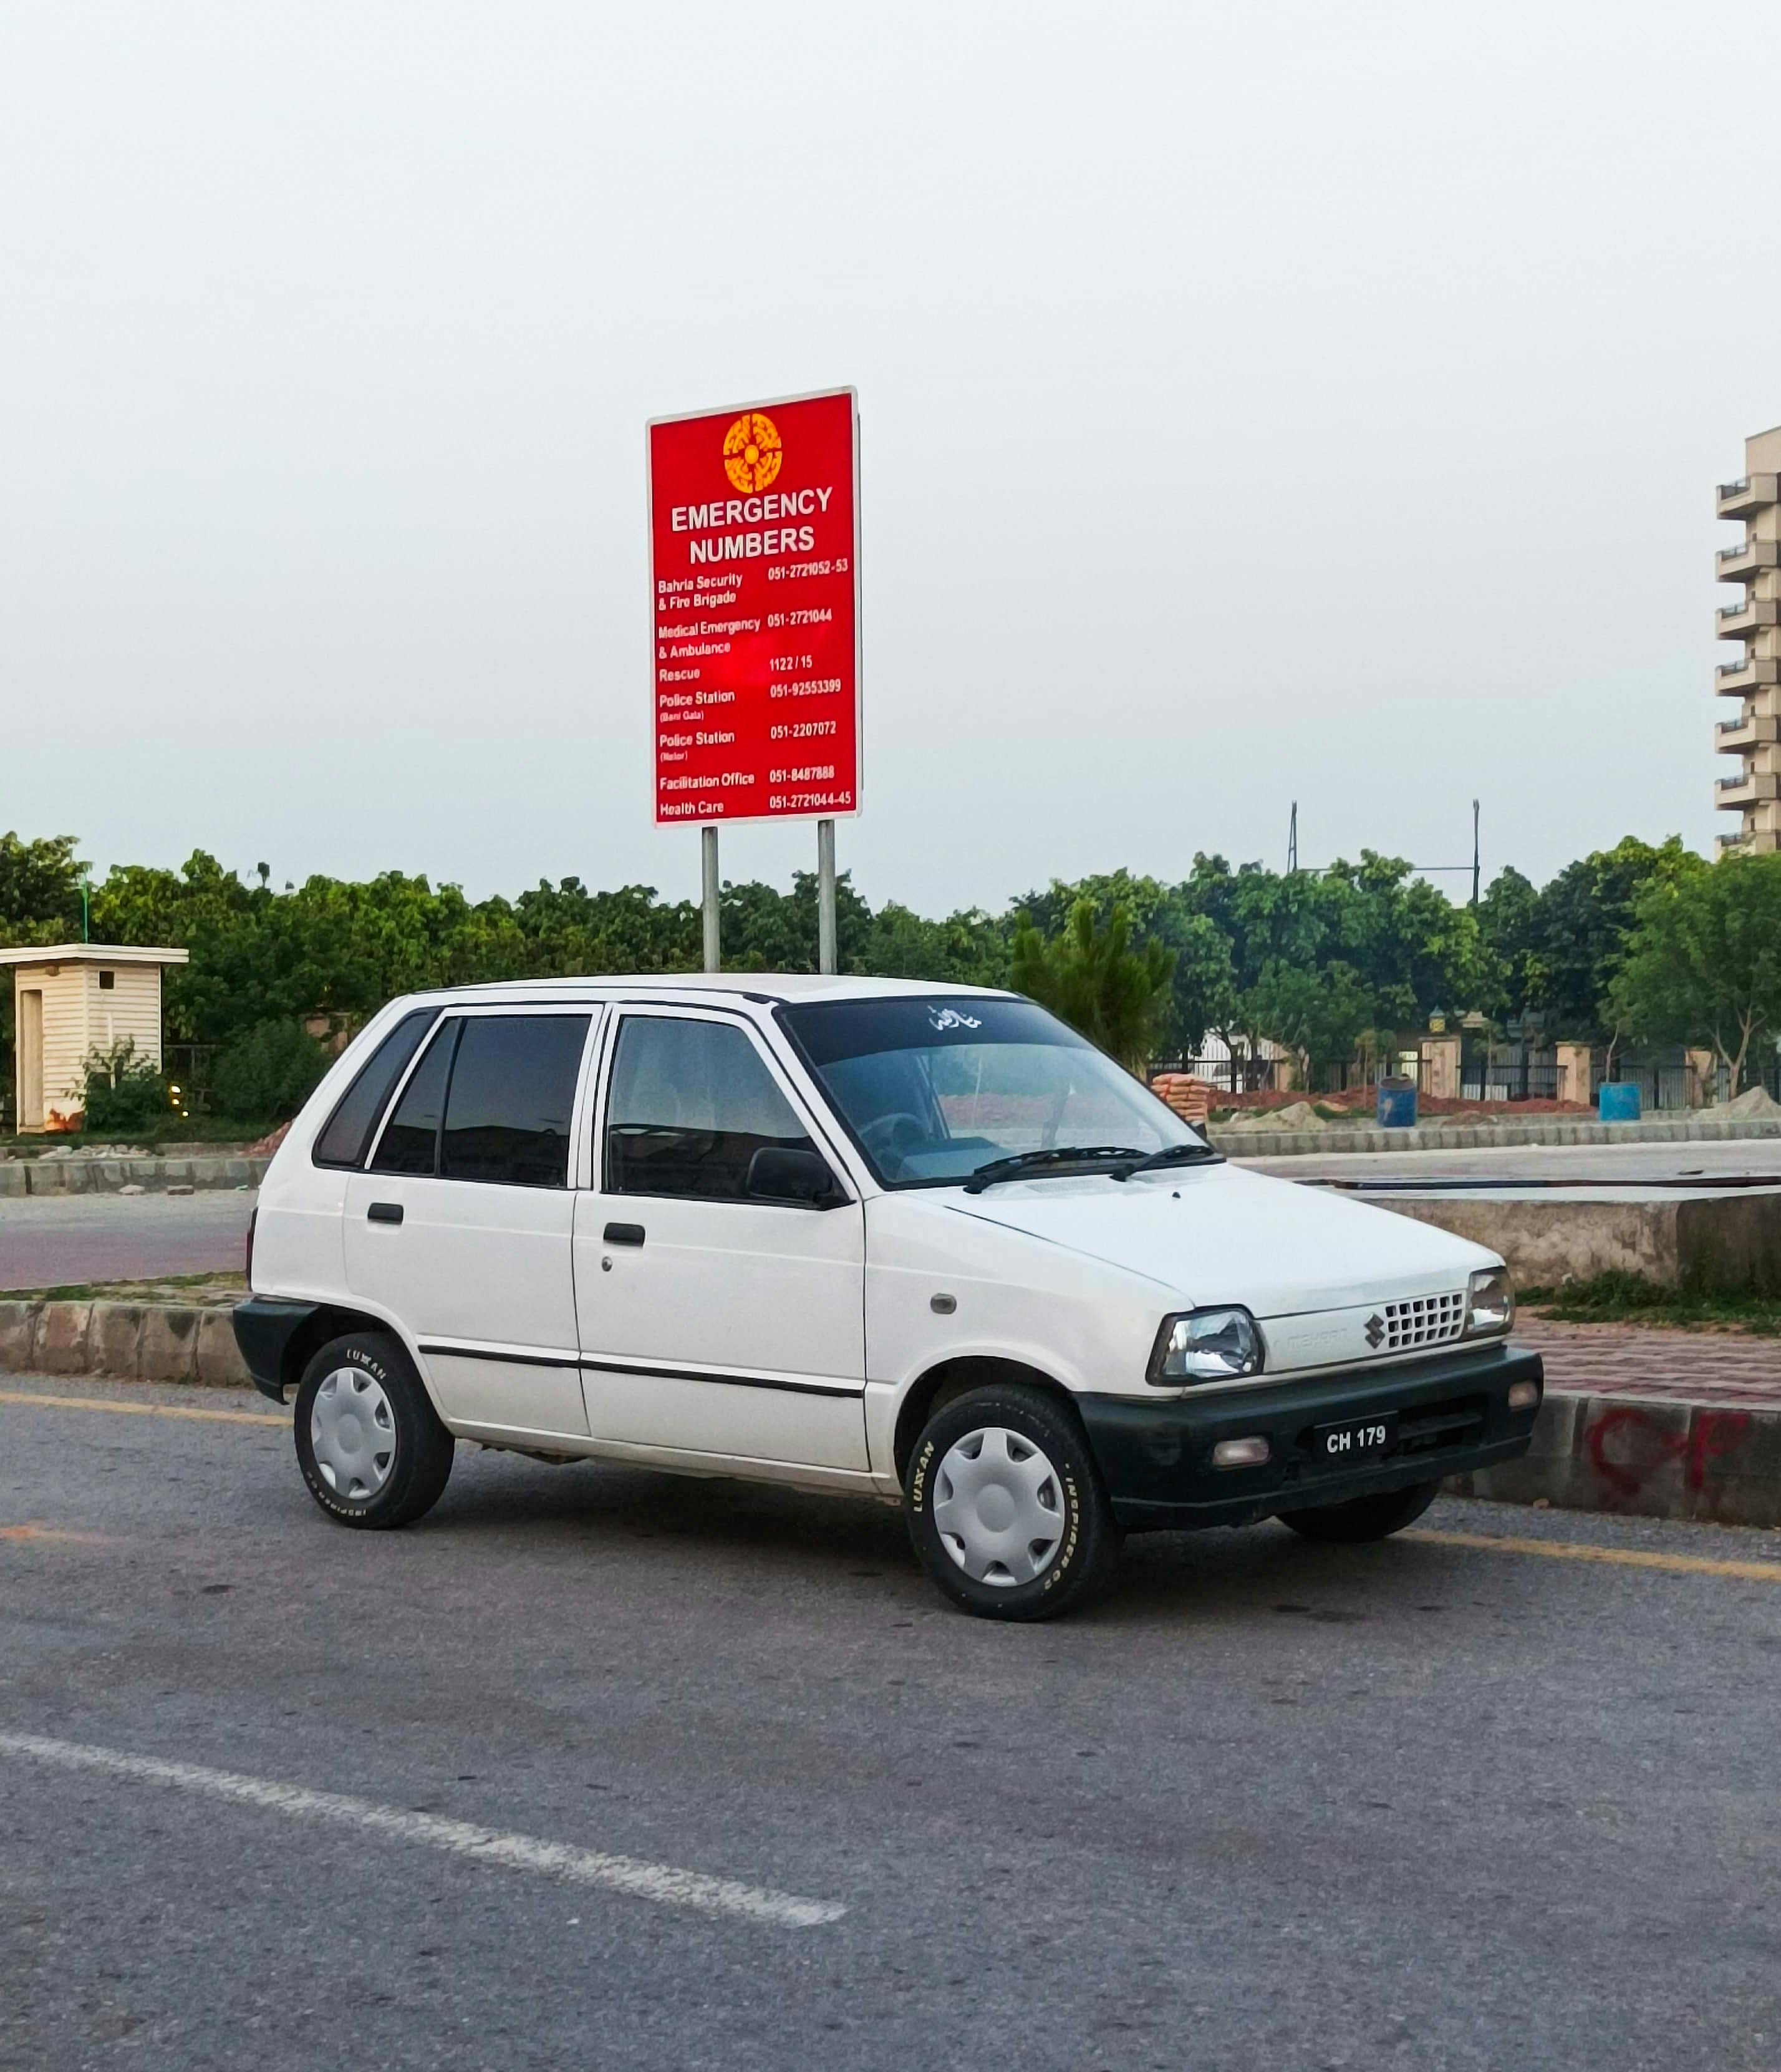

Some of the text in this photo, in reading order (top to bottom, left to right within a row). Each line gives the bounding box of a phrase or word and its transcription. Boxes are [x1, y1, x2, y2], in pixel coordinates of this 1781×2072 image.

[672, 487, 833, 532] EMERGENCY
[690, 526, 815, 564] NUMBERS
[659, 558, 848, 593] Bahria Security 051-2721052-53
[659, 590, 736, 611] & Fire Brigade
[659, 609, 833, 639] Medical Emergency 051-2721044
[659, 642, 731, 659] & Ambulance
[659, 669, 700, 682] Rescue
[770, 656, 793, 671] 1122
[660, 694, 693, 707] Police
[695, 690, 735, 704] Station
[660, 720, 836, 747] Police Station 051-2207072
[660, 775, 720, 790] Facilitation
[721, 772, 755, 786] Office
[660, 791, 851, 815] Health Care 051-2721044-45
[1327, 1425, 1386, 1453] CH 179
